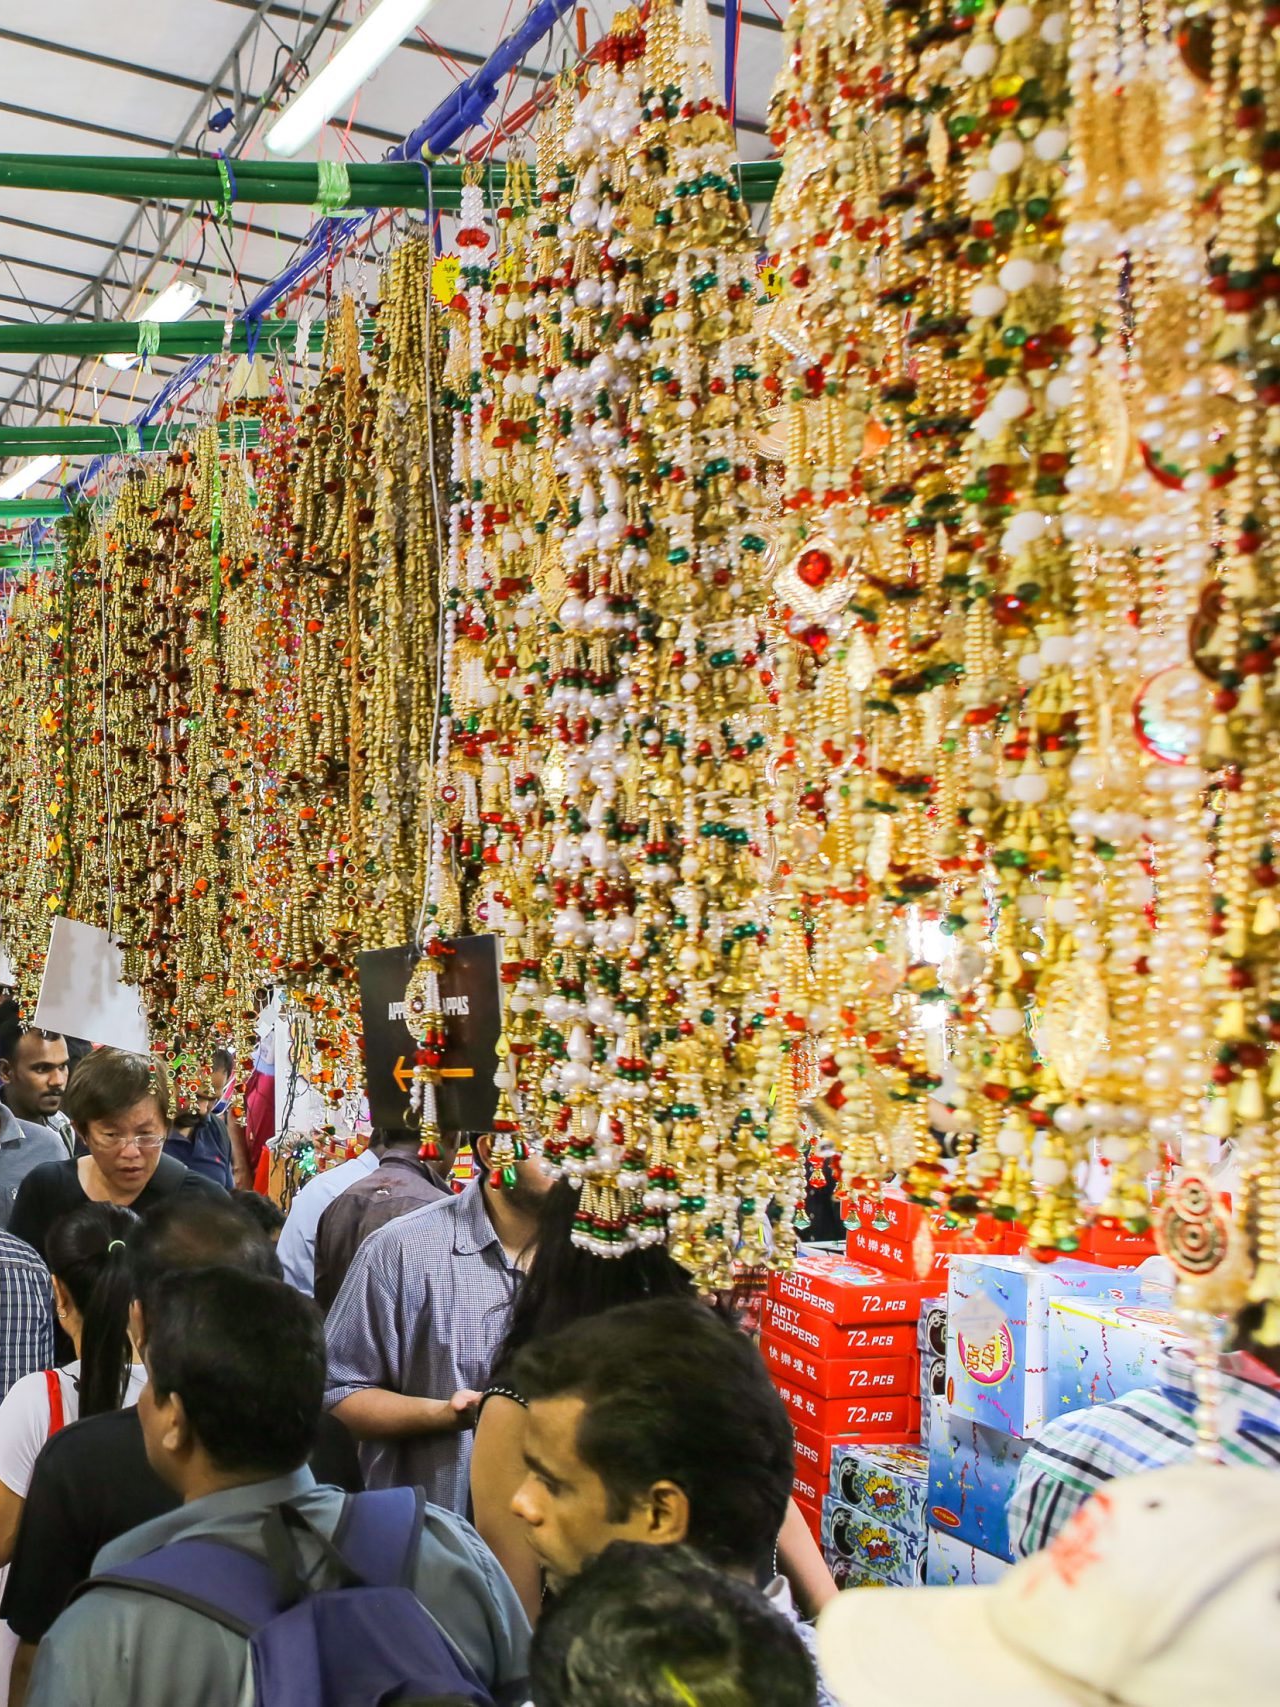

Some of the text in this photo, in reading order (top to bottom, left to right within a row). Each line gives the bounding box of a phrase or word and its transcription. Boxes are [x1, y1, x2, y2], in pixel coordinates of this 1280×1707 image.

[765, 1298, 800, 1324] PARTY
[780, 1282, 835, 1314] POPPERS
[771, 1315, 820, 1348] POPPERS
